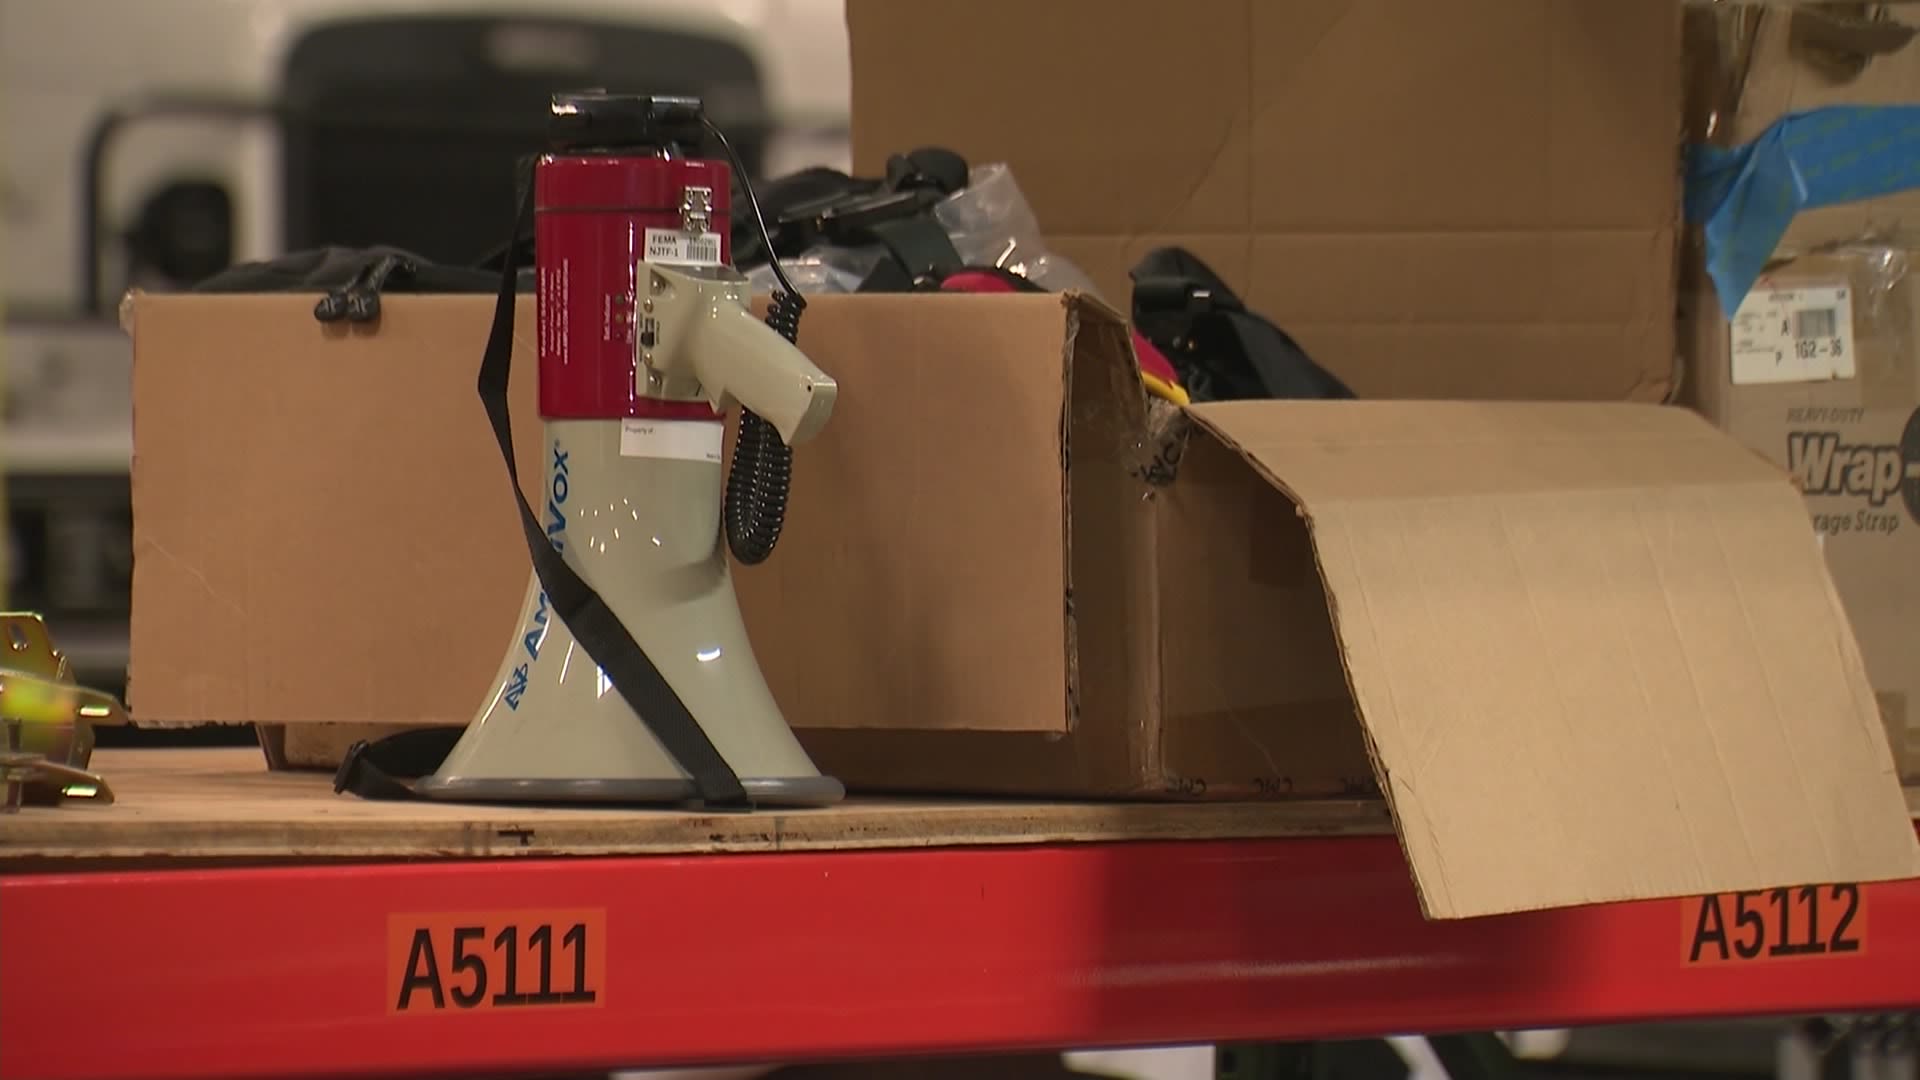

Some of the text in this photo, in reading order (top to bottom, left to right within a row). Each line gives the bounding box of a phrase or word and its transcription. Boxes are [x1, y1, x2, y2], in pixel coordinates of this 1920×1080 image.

[649, 246, 679, 257] NJTF-1
[652, 234, 677, 245] FEMA
[1812, 510, 1900, 536] rage Strap
[1689, 882, 1859, 963] A5112
[397, 922, 596, 1011] A5111
